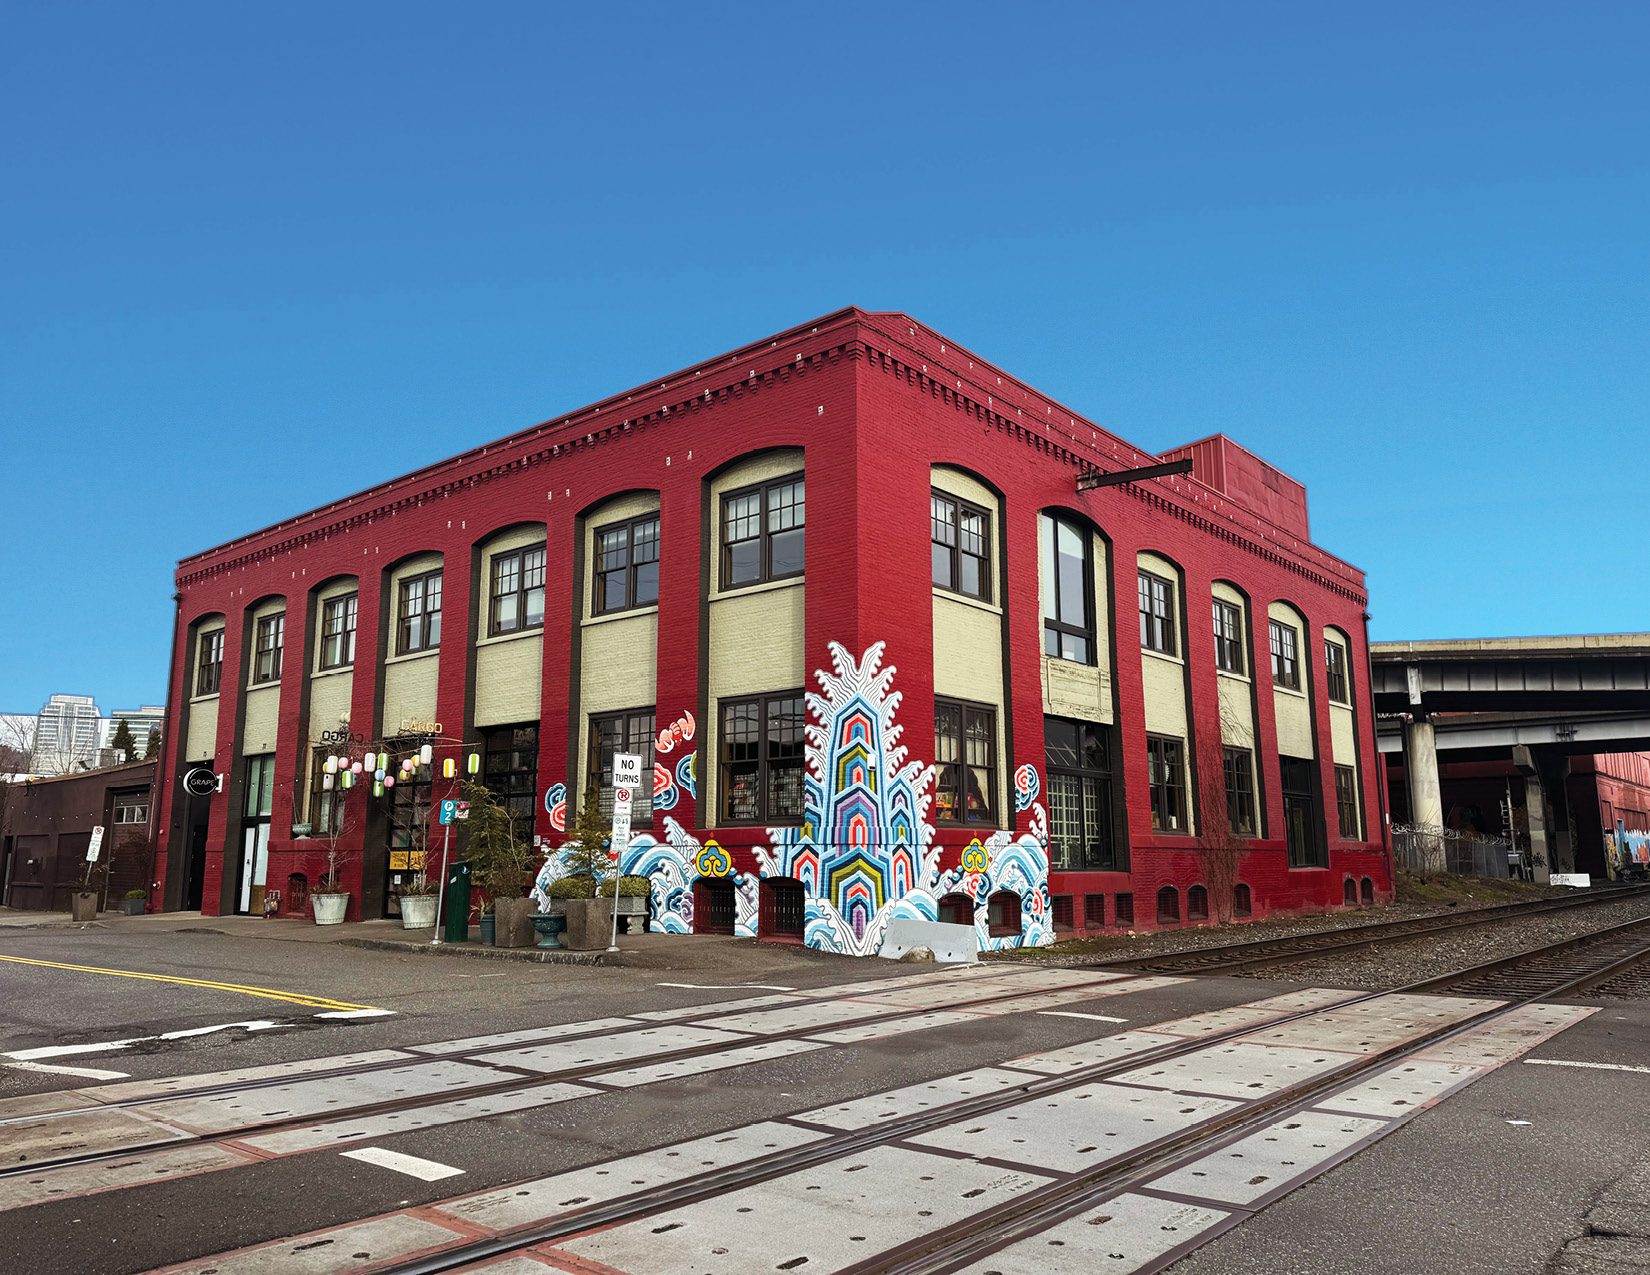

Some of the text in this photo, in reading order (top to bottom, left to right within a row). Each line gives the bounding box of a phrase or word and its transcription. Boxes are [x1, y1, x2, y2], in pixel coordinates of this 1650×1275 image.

[401, 719, 443, 734] CARGO
[621, 759, 634, 770] NO
[190, 778, 215, 787] GRAPE
[615, 773, 639, 784] TURNS
[444, 811, 451, 821] 2
